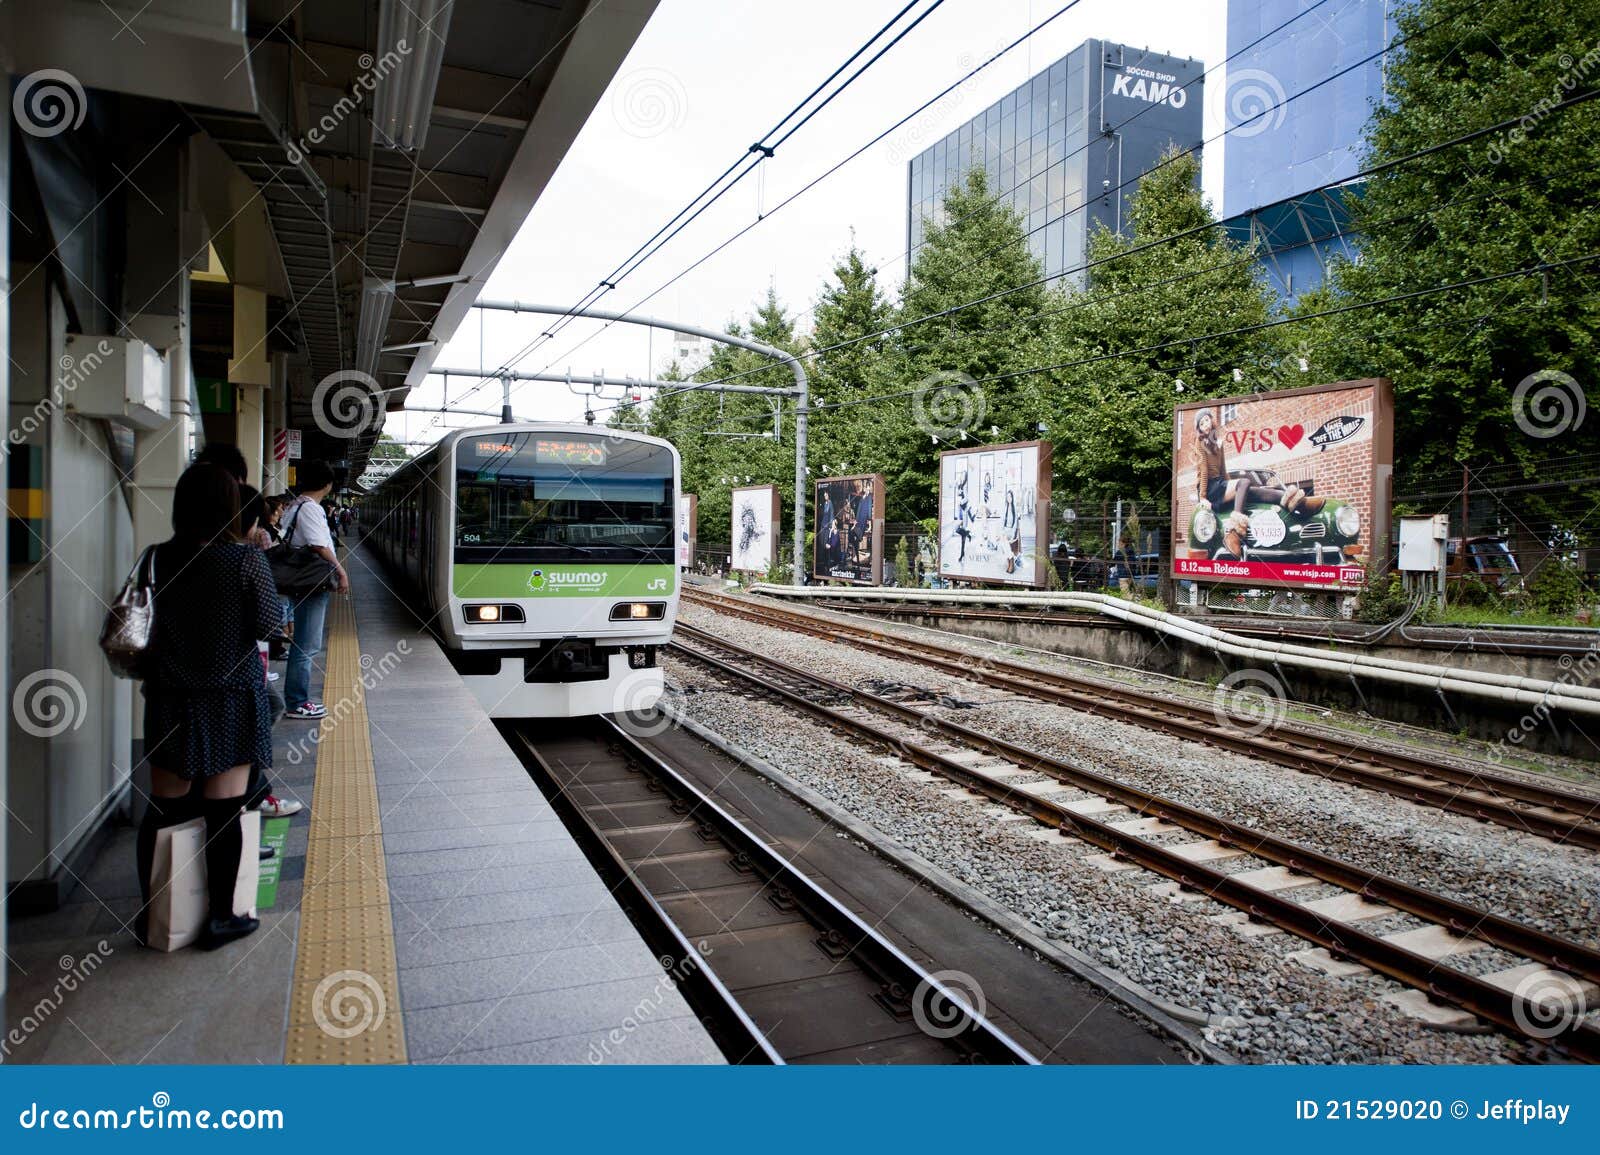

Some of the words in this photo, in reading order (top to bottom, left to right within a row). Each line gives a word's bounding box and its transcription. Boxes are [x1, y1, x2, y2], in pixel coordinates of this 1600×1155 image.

[1126, 66, 1155, 78] SOCCER
[1156, 72, 1176, 82] SHOP
[1112, 74, 1187, 109] KAMO
[209, 382, 222, 409] 1
[1226, 427, 1274, 454] ViS
[1329, 429, 1343, 441] THE
[463, 534, 481, 543] 504
[1181, 561, 1198, 573] 9.12
[1213, 562, 1250, 576] Release
[549, 572, 601, 583] suumo
[647, 579, 667, 591] JR
